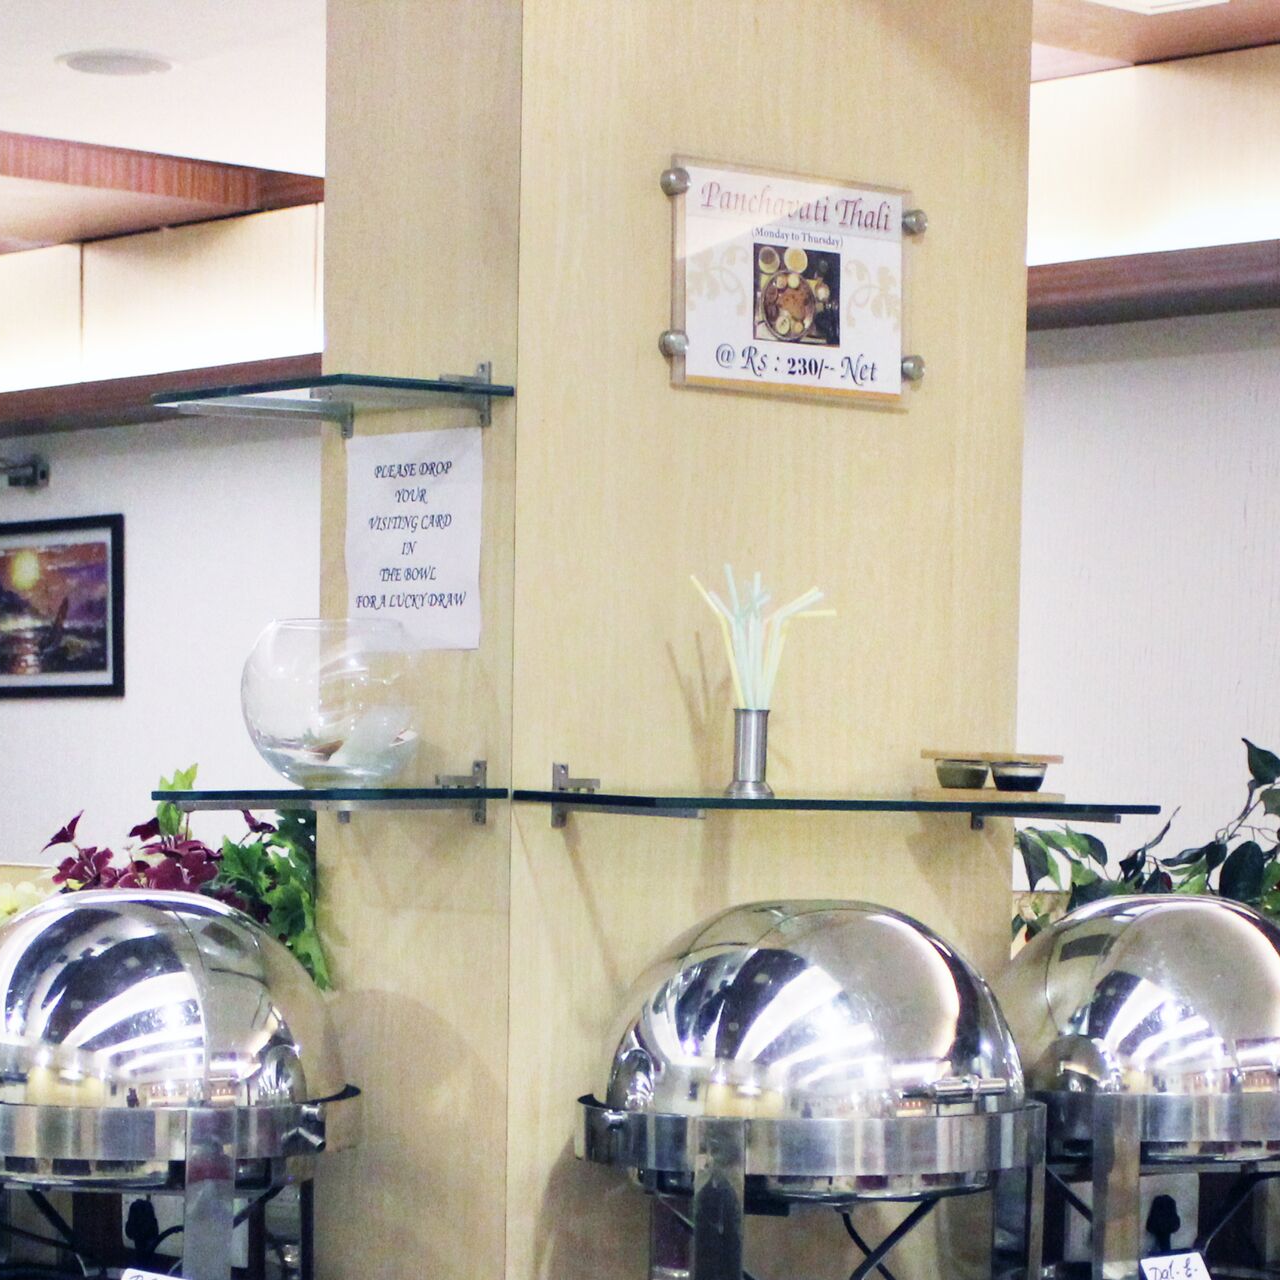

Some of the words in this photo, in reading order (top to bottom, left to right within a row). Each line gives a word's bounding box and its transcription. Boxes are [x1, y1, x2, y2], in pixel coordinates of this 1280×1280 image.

[701, 181, 830, 223] Panchavati
[835, 198, 892, 232] Thali
[752, 226, 789, 241] (Monday
[791, 232, 800, 241] to
[801, 232, 843, 249] Thursday)
[840, 353, 878, 386] Net
[374, 463, 417, 479] PLEASE
[419, 460, 453, 478] DROP
[395, 487, 428, 504] YOUR
[369, 515, 418, 532] VISITING
[421, 513, 452, 530] CARD
[401, 541, 417, 556] IN
[380, 568, 402, 582] THE
[404, 565, 437, 582] BOWL
[356, 594, 379, 610] FOR
[376, 593, 387, 608] A
[389, 592, 427, 610] LUCKY
[427, 590, 467, 609] DRAW
